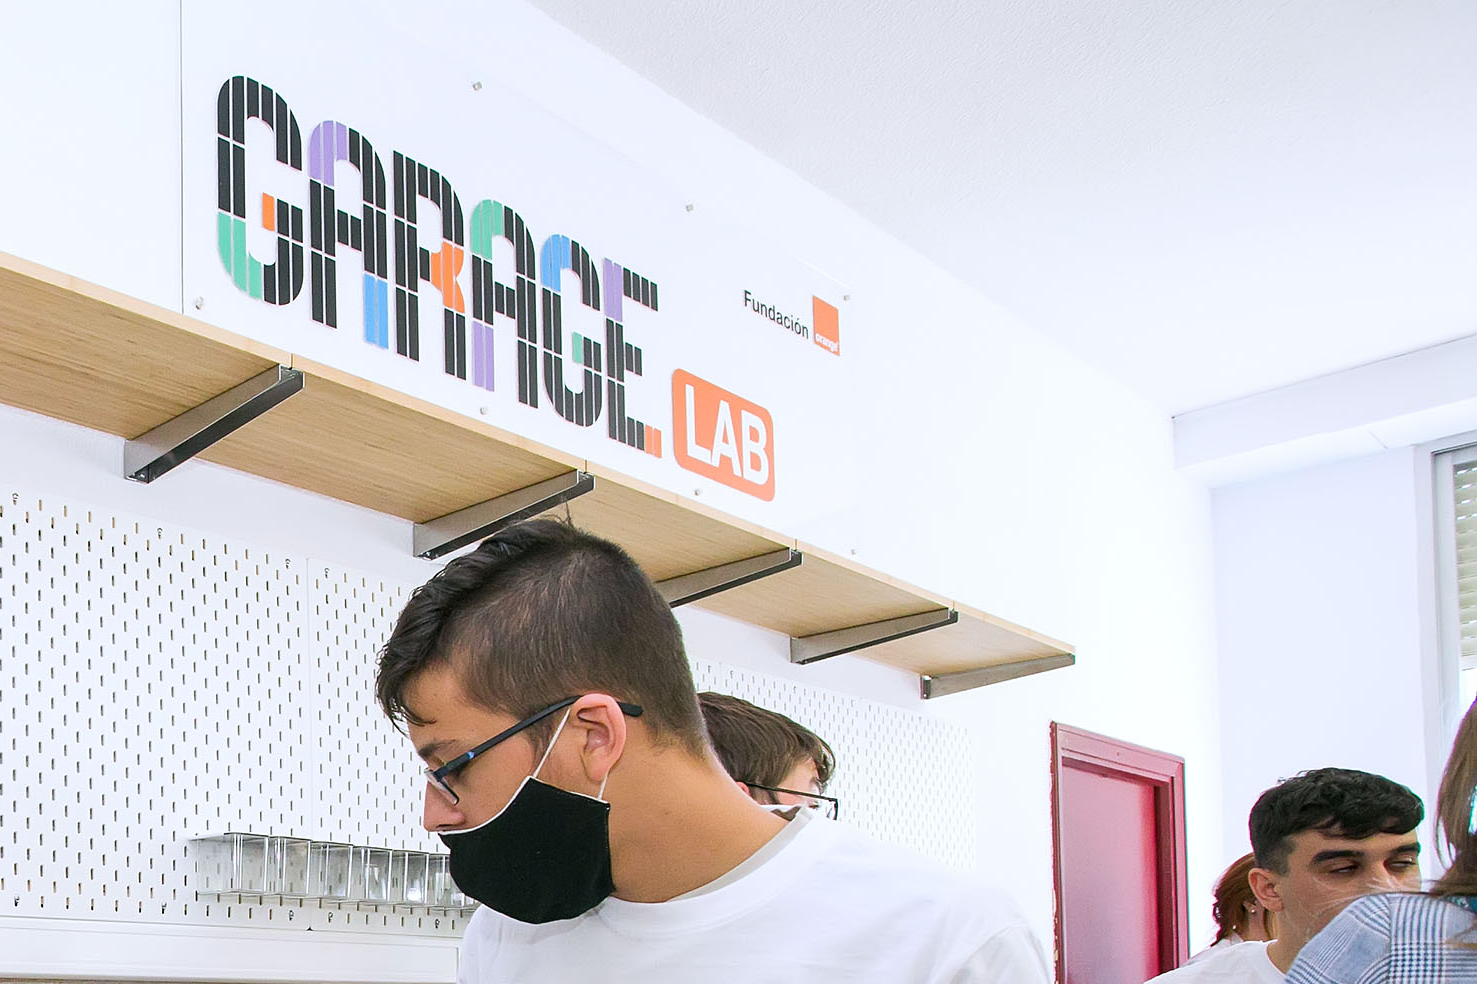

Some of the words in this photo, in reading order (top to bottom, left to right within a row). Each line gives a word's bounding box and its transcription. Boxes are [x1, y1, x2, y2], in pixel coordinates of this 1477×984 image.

[217, 75, 662, 458] GARAGE
[686, 384, 769, 485] LAB
[743, 289, 809, 340] Fundación
